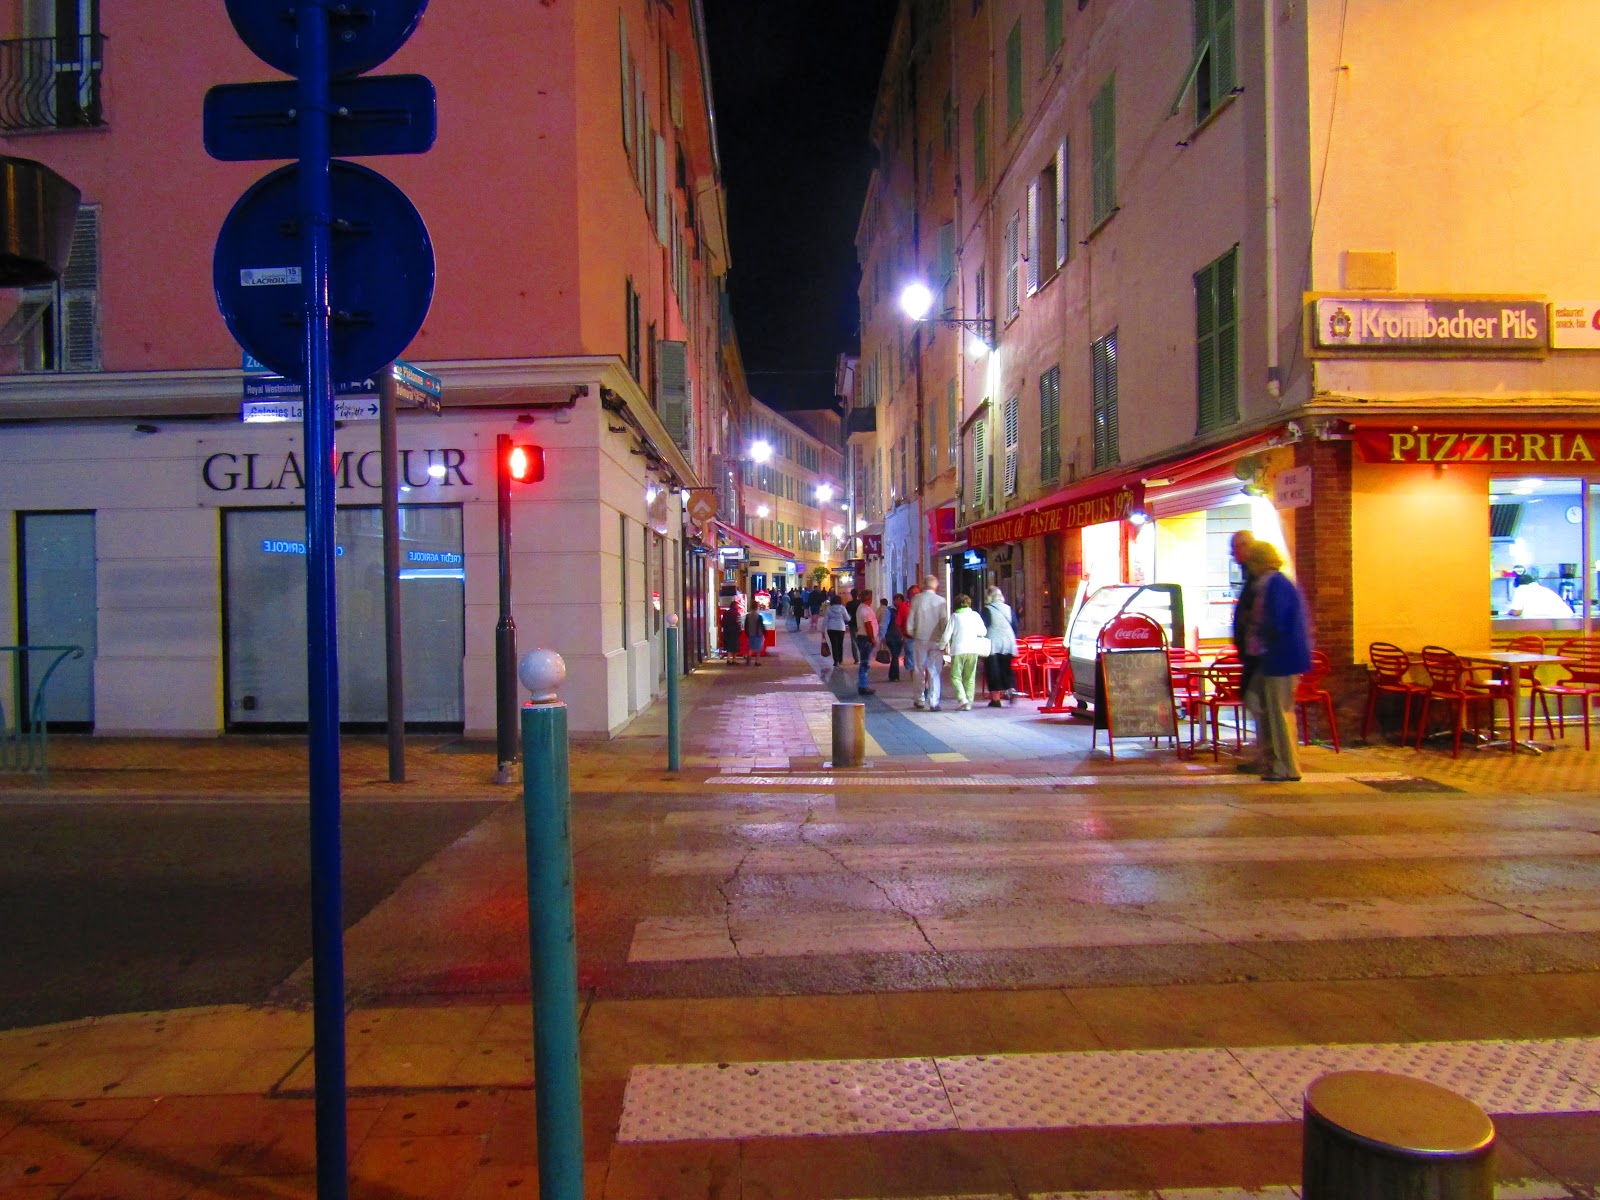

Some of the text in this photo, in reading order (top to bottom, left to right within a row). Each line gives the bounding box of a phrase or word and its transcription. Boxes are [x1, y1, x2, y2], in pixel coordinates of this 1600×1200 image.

[251, 276, 286, 285] LACROIX
[1555, 308, 1585, 317] restaurant
[1361, 308, 1538, 340] Krombacher Pils
[247, 383, 302, 395] Royal Westminster
[1389, 433, 1595, 462] PIZZERIA
[971, 520, 1013, 546] RESTAURANT
[1029, 508, 1063, 533] PASTRE
[1067, 495, 1110, 527] DEPUIS
[1115, 627, 1150, 640] Coca-Cola
